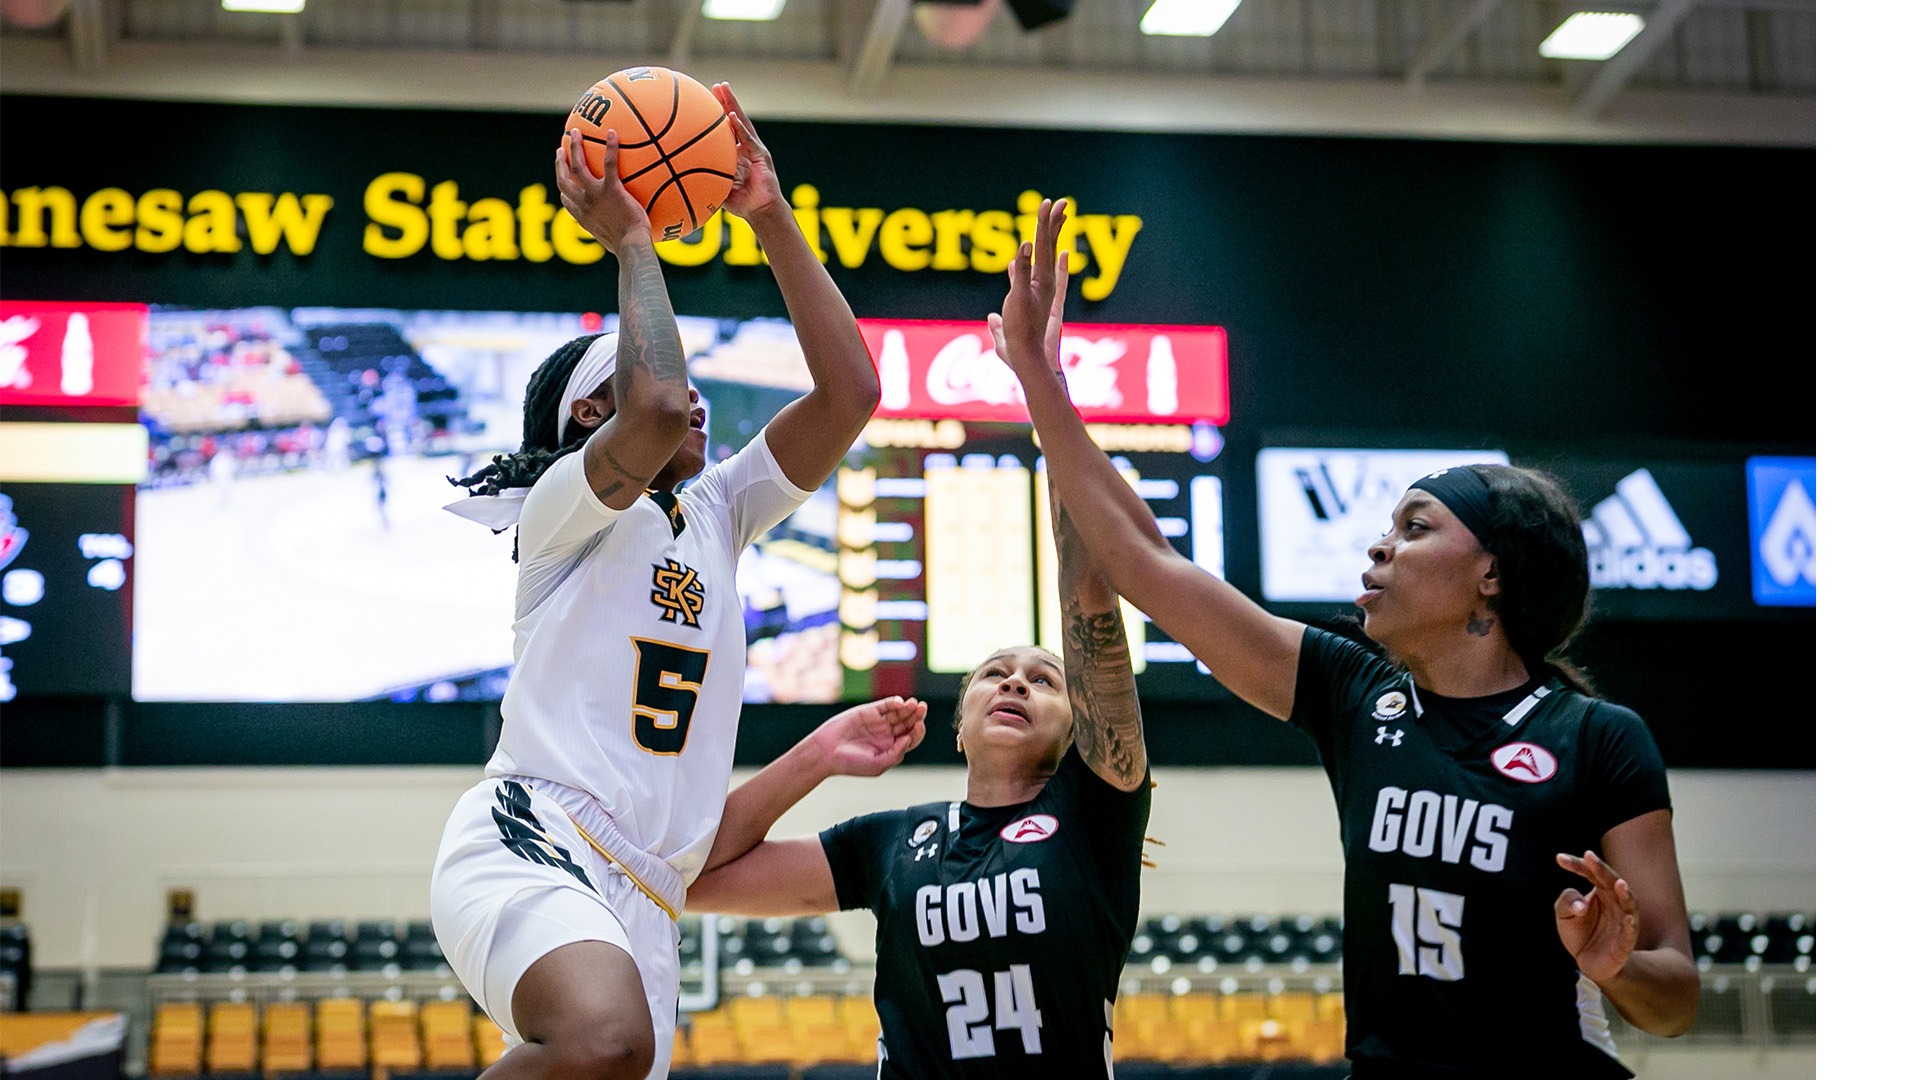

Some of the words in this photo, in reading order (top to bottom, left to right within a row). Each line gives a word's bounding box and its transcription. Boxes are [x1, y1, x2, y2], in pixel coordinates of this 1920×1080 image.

[0, 186, 333, 255] nesaw
[629, 635, 711, 757] 5
[1369, 786, 1514, 873] GOVS
[915, 867, 1046, 947] GOVS
[1388, 883, 1465, 981] 15
[936, 964, 1043, 1060] 24
